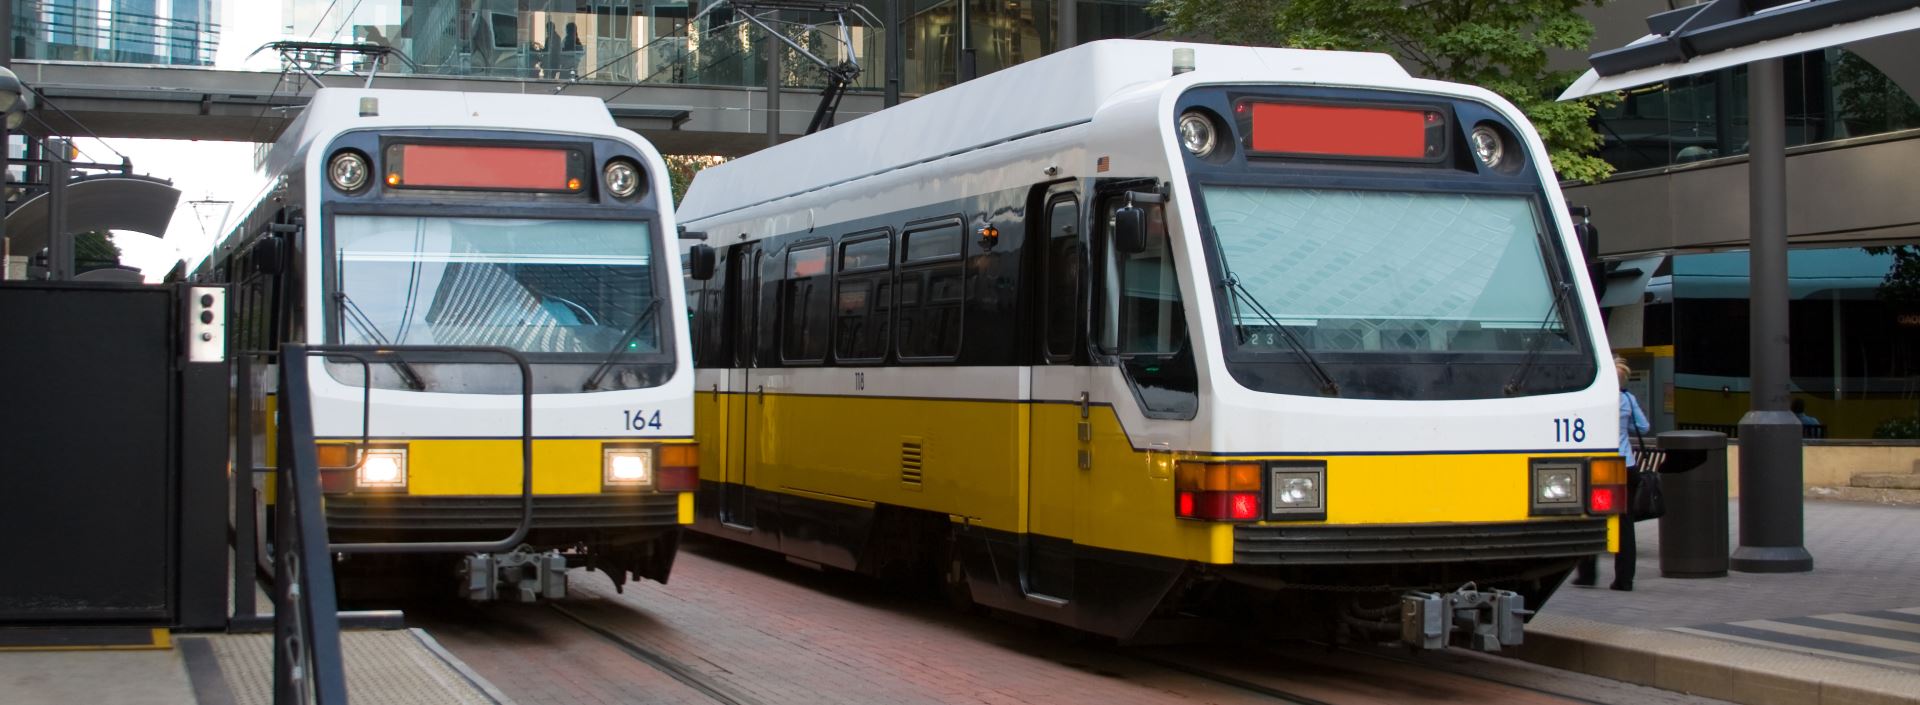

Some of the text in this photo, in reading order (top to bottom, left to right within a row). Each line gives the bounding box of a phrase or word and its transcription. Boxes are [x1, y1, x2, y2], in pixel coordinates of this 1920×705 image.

[1251, 333, 1274, 345] 2 3
[623, 409, 662, 431] 164
[1553, 417, 1586, 443] 118
